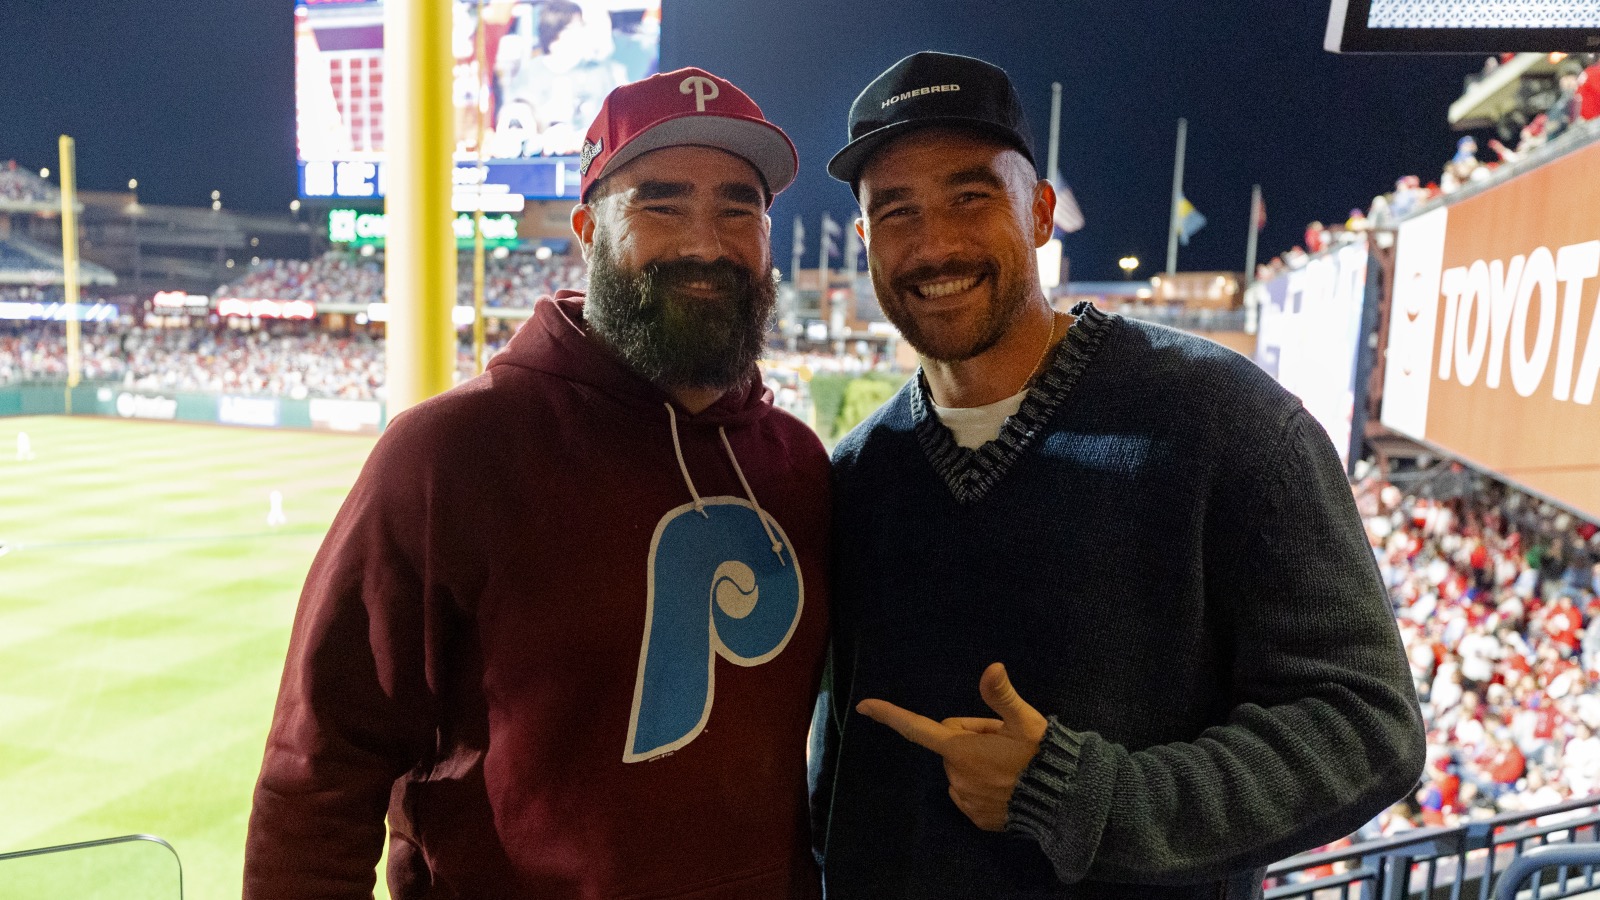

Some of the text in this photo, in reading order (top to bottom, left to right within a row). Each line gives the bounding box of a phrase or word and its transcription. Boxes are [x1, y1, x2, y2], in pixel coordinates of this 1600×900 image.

[679, 76, 719, 112] P
[881, 84, 961, 109] HOMEBRED
[622, 495, 805, 764] P
